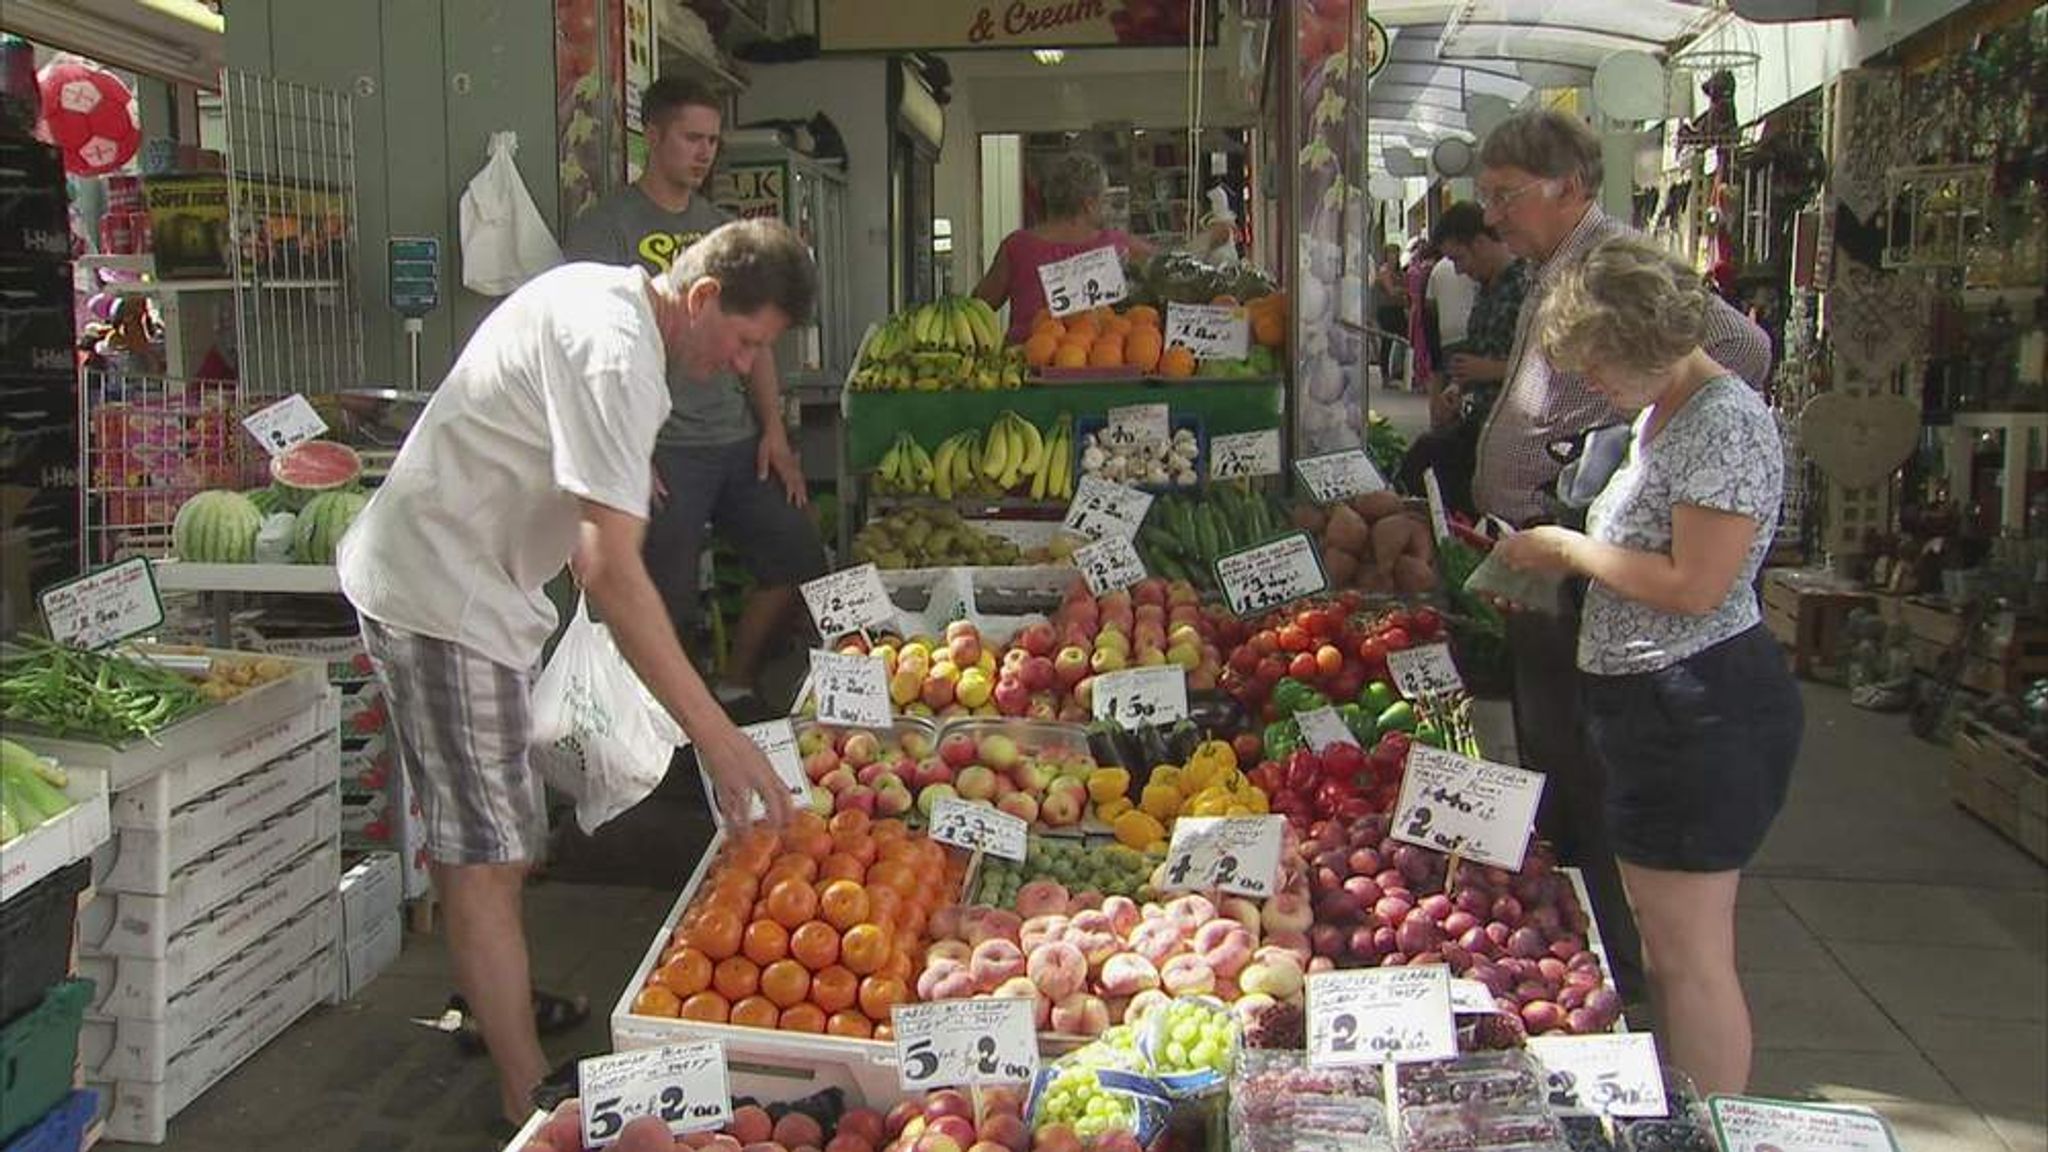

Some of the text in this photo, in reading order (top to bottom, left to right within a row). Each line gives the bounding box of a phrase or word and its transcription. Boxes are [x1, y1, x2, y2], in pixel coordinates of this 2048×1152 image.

[968, 0, 1106, 42] & Cream
[1051, 286, 1071, 312] 5
[1169, 854, 1192, 884] 4
[905, 1039, 939, 1080] 5
[590, 1096, 623, 1139] 5
